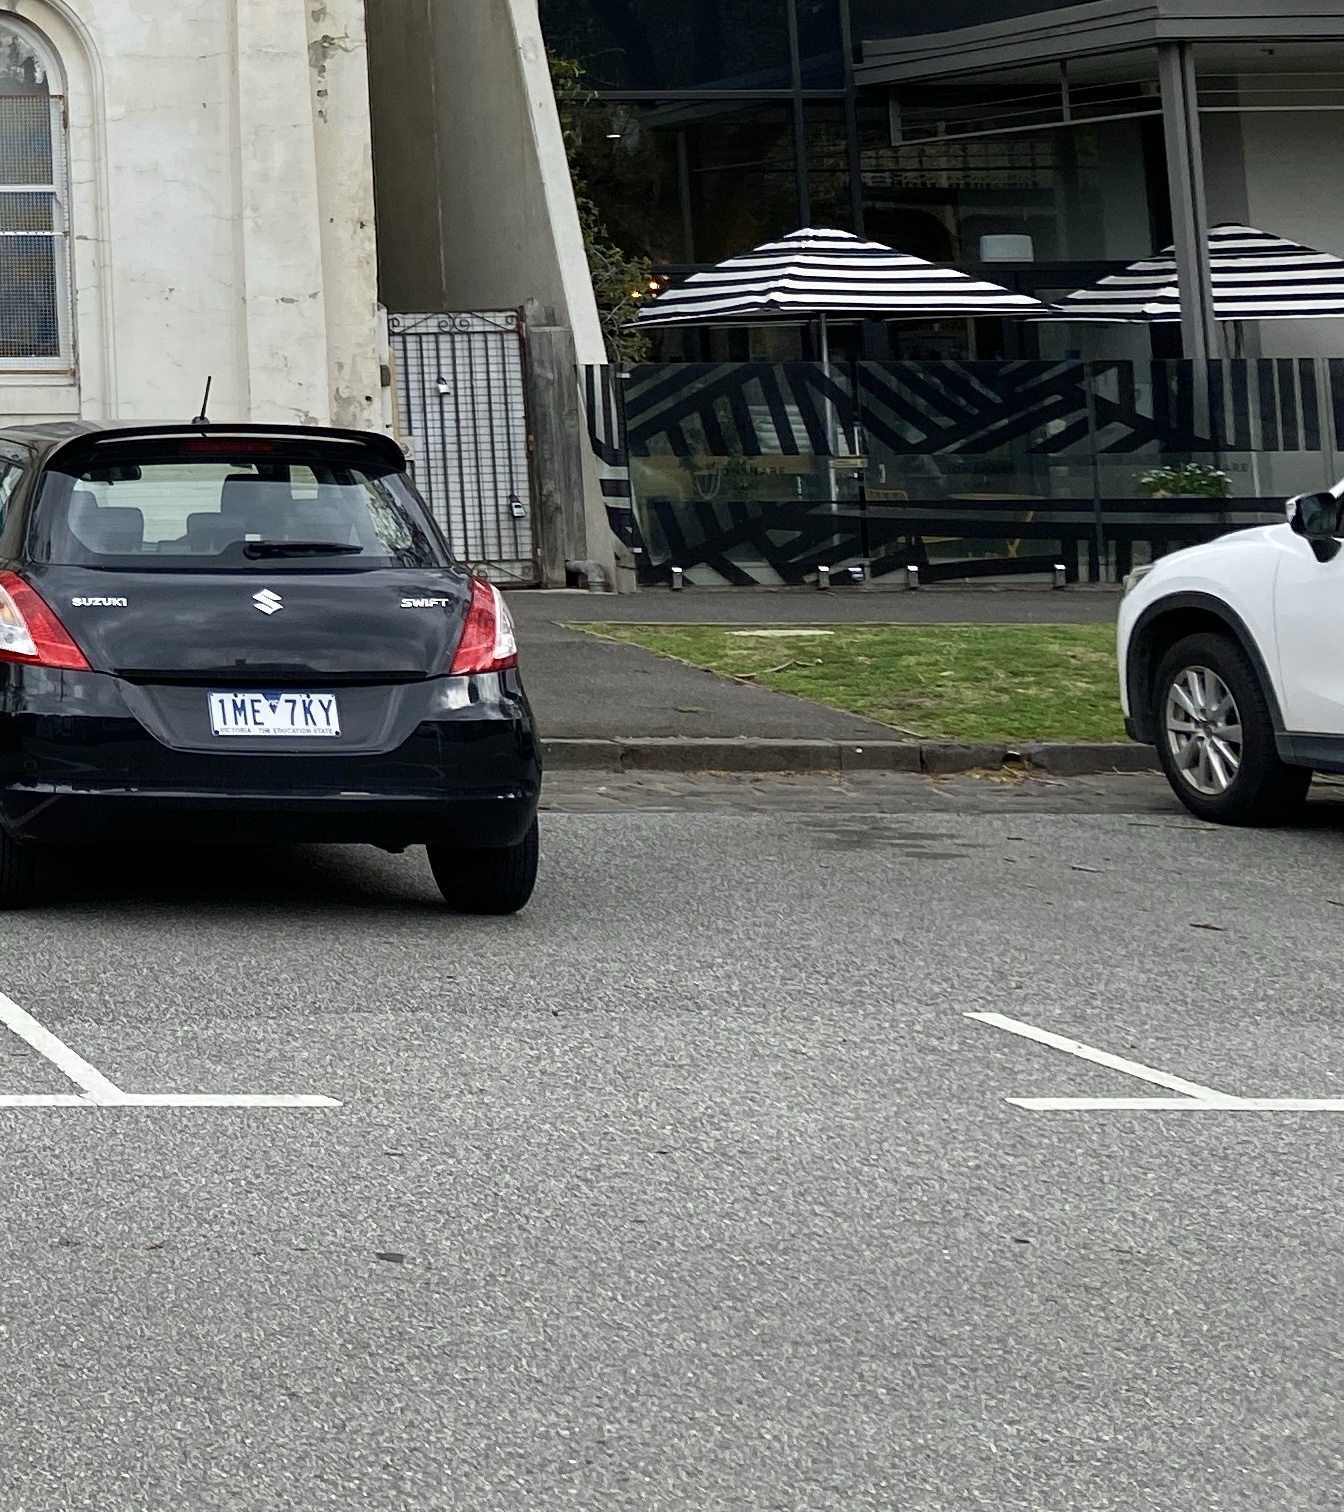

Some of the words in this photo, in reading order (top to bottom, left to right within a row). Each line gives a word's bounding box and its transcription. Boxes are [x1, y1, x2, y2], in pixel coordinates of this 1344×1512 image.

[71, 597, 128, 607] SUZUKI
[400, 598, 450, 608] SWIFT
[218, 698, 265, 726] 1ME
[284, 698, 333, 727] 7KY
